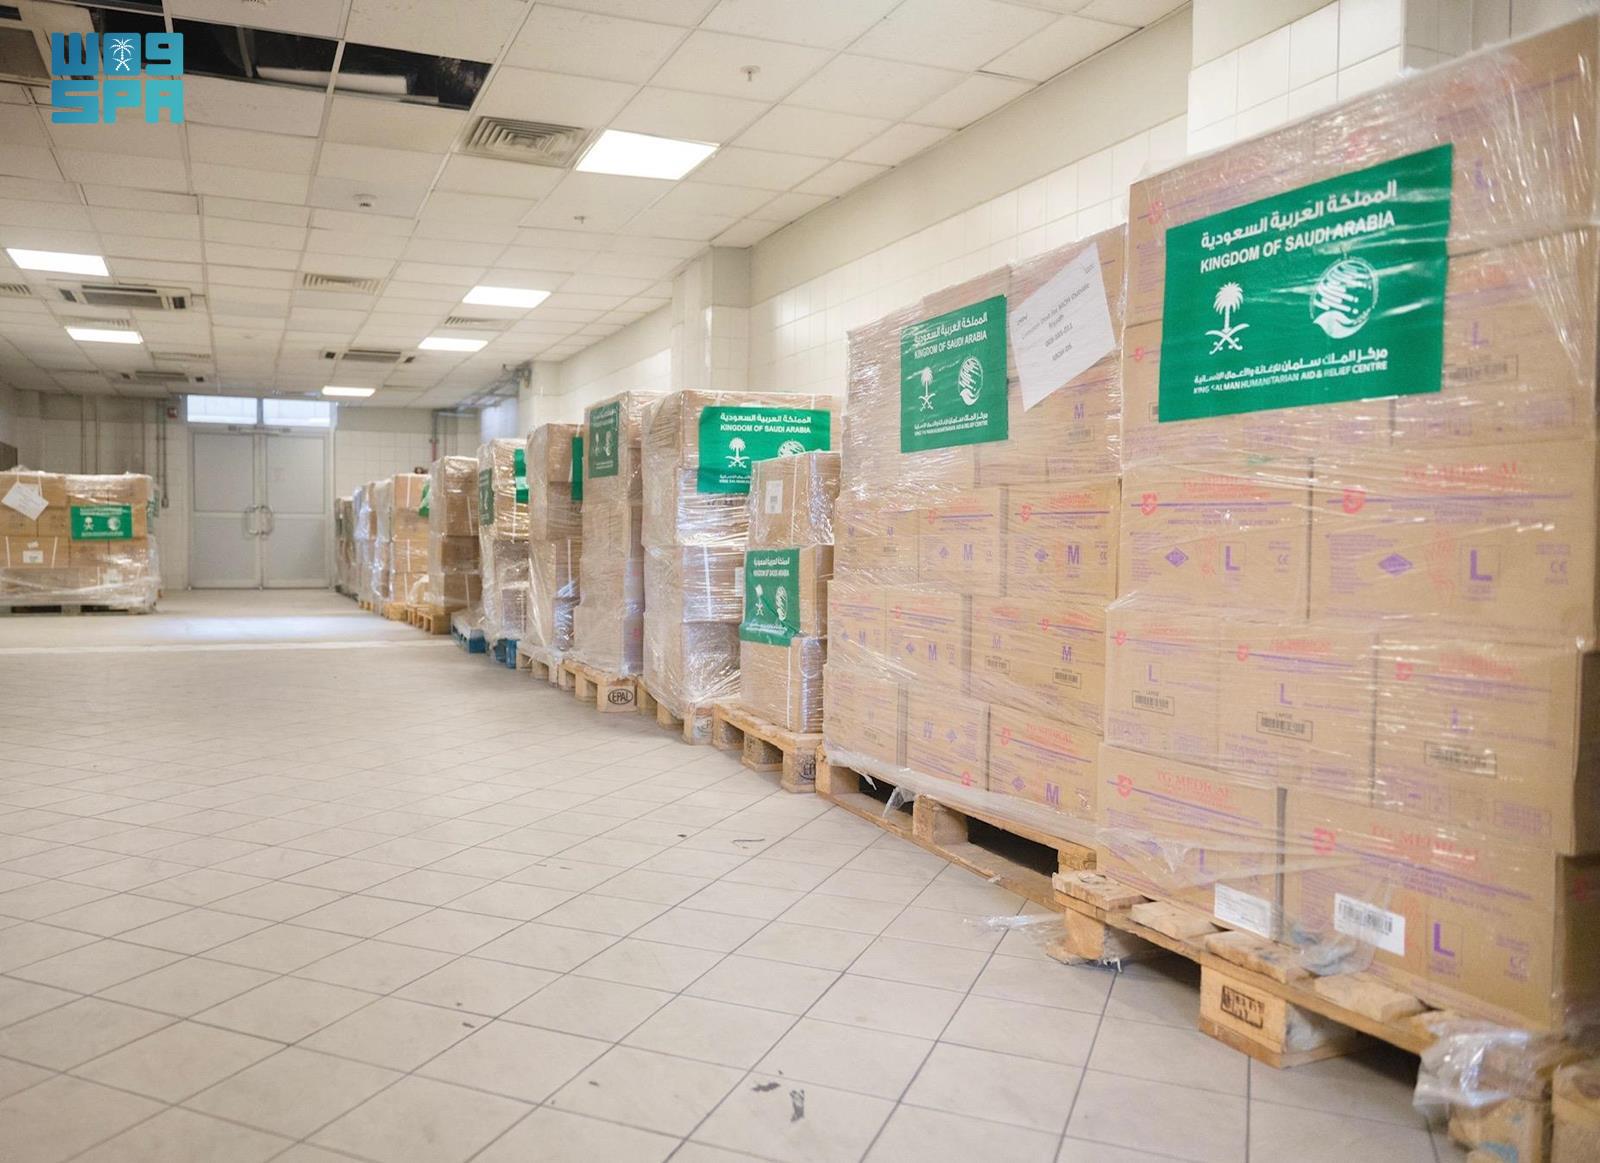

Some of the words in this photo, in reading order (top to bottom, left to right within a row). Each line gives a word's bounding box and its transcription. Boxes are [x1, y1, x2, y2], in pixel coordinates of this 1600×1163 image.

[1327, 180, 1397, 213] المملكة
[1270, 200, 1324, 231] العربية
[1200, 246, 1260, 274] KINGDOM
[1262, 239, 1281, 258] OF
[1285, 227, 1330, 253] SAUDI
[1329, 210, 1395, 239] ARABIA
[1201, 217, 1268, 250] السعودية
[914, 343, 939, 360] KINGDOM
[938, 341, 947, 353] OF
[946, 336, 964, 351] SAUDI
[964, 330, 987, 346] ARABIA
[1357, 346, 1388, 364] مركز
[1282, 357, 1321, 373] سلمان
[1352, 360, 1388, 375] CENTRE
[720, 412, 756, 424] السعودية
[720, 424, 752, 432] KINGDOM
[753, 425, 764, 433] OF
[764, 426, 785, 434] SAUDI
[786, 426, 811, 434] ARABIA
[783, 414, 811, 424] المملكة
[1067, 544, 1080, 565] M
[1225, 545, 1240, 571] L
[1470, 550, 1493, 581] L
[1062, 645, 1072, 662] M
[1279, 683, 1293, 705] L
[1046, 782, 1059, 808] M
[1433, 922, 1455, 958] L
